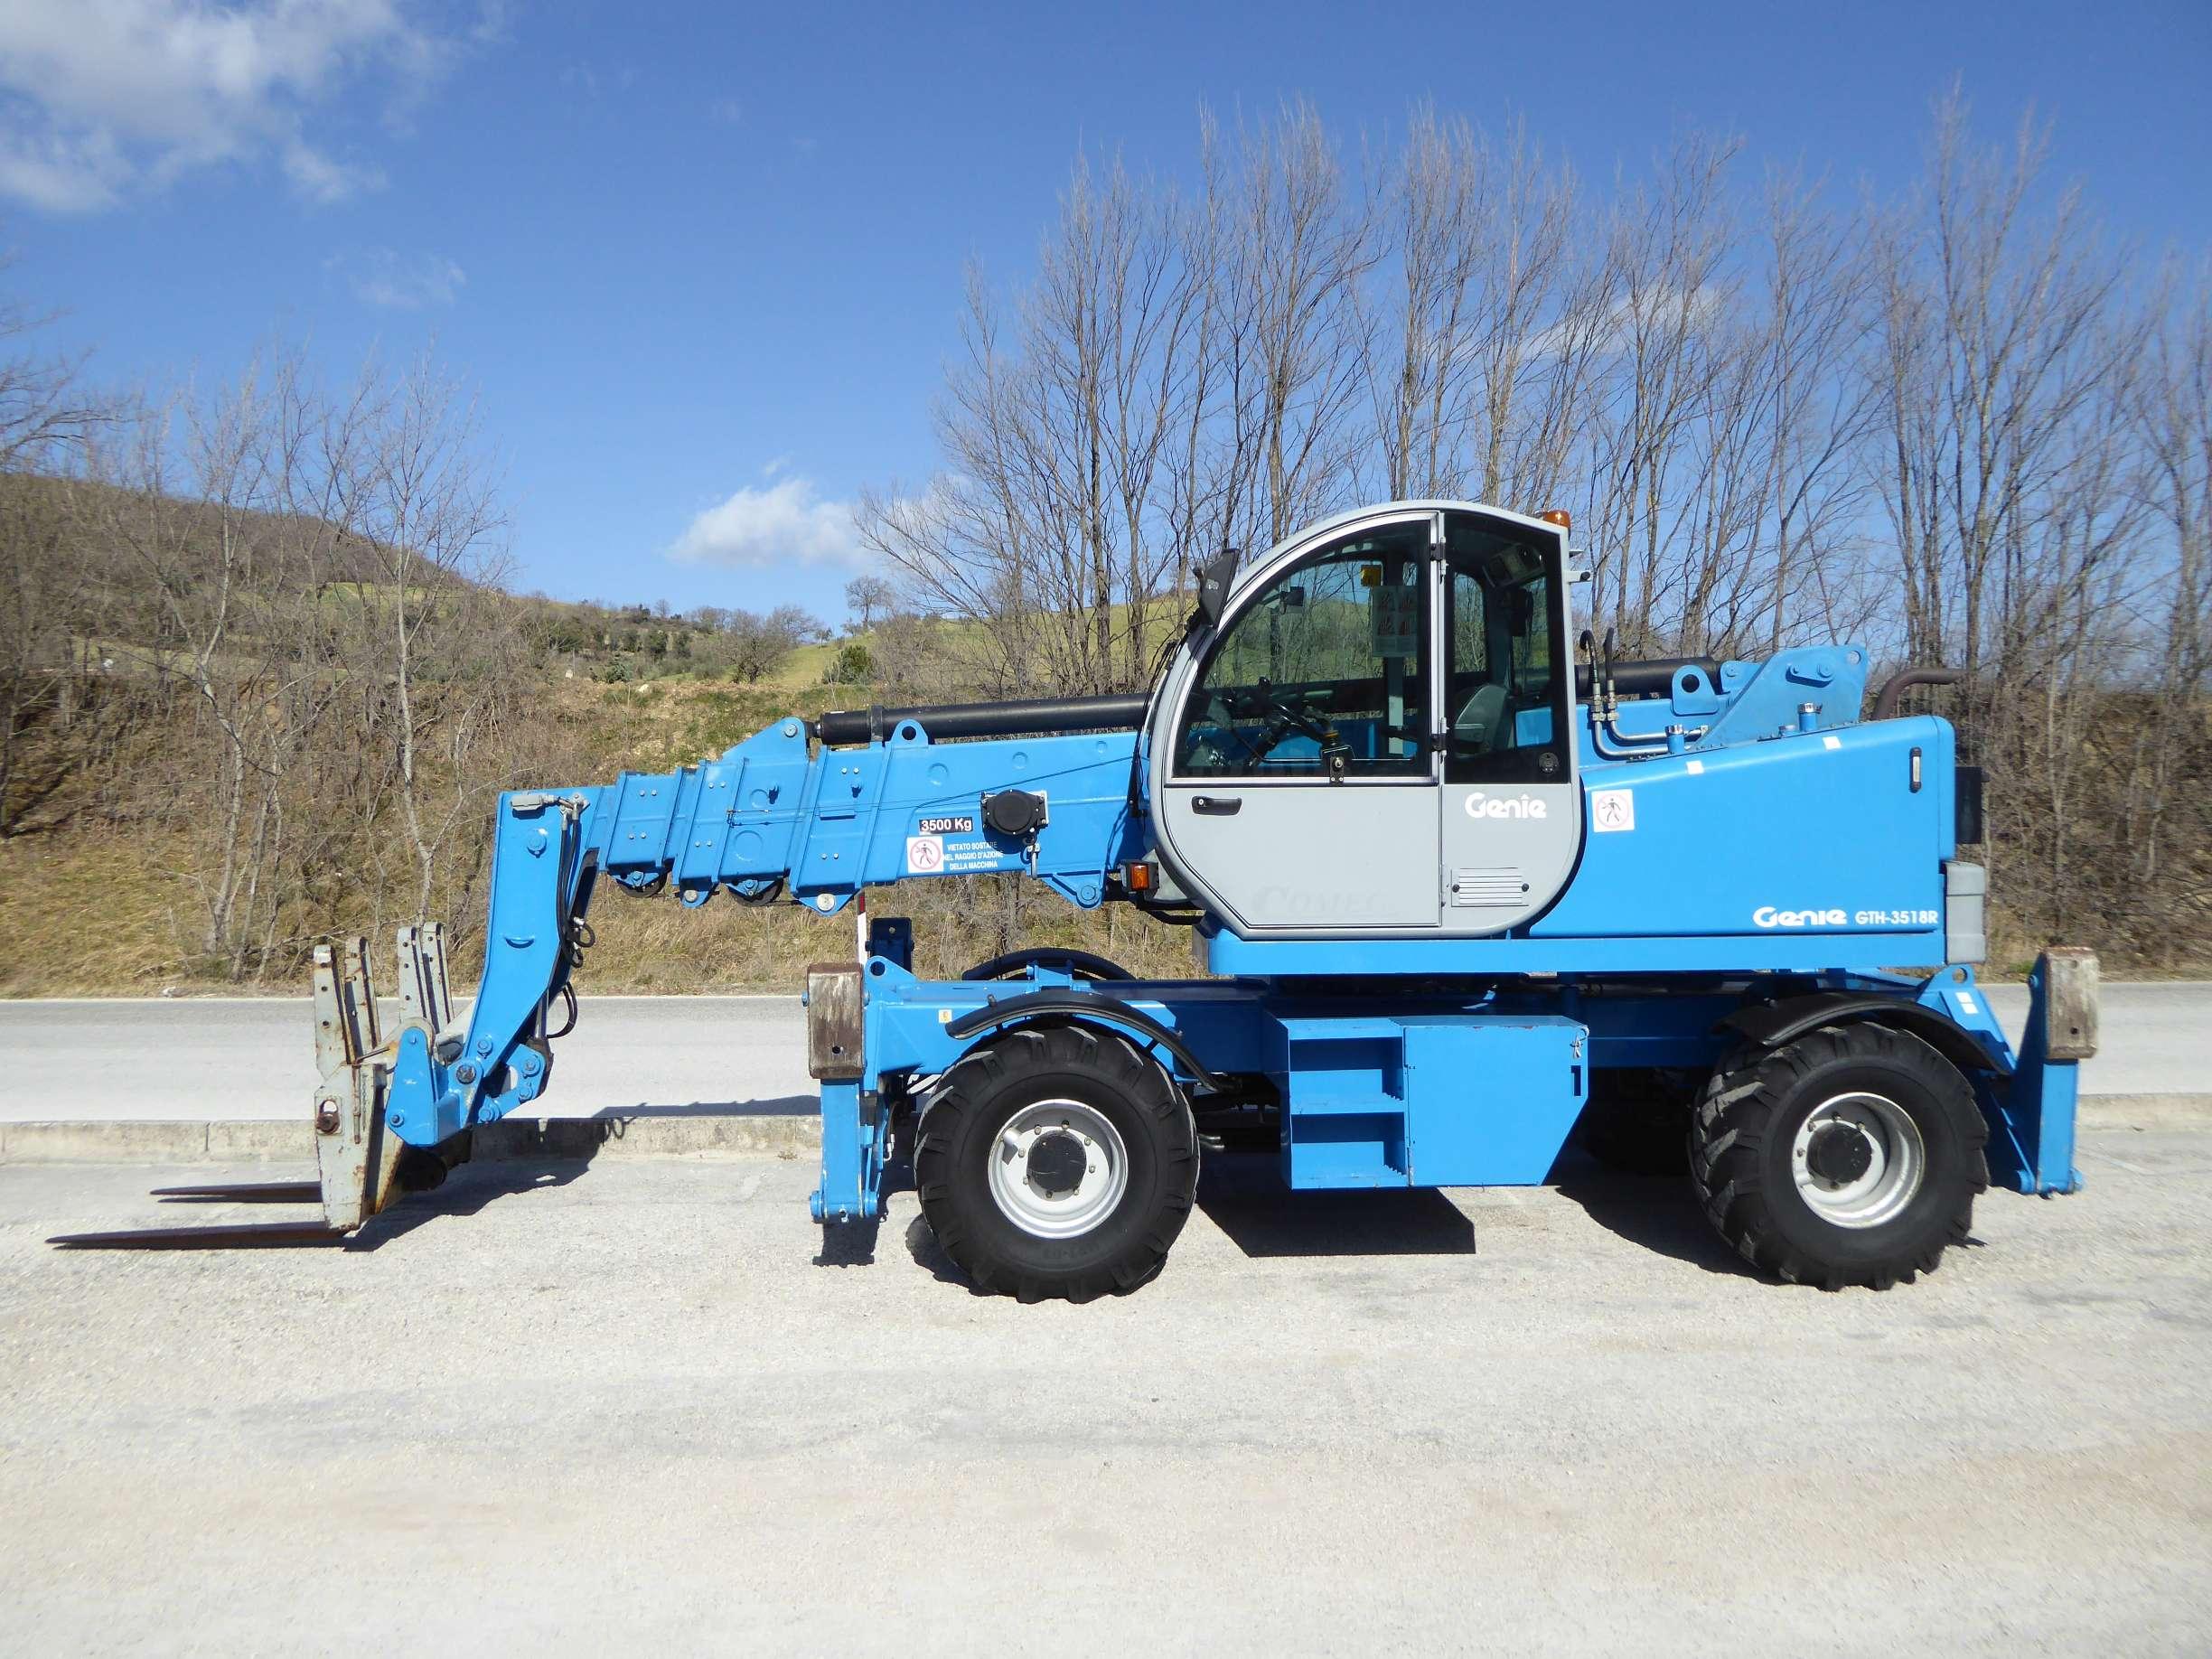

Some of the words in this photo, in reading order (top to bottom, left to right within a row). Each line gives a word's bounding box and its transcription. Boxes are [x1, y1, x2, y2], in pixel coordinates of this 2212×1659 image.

[1465, 792, 1547, 819] Genie
[922, 820, 951, 831] 3500
[955, 818, 971, 831] Kg
[955, 852, 976, 860] RAGGIO
[950, 862, 968, 870] DELLA
[969, 860, 998, 869] MACCHINA
[1753, 906, 1847, 928] Genie
[1855, 910, 1938, 925] GTH-3518R
